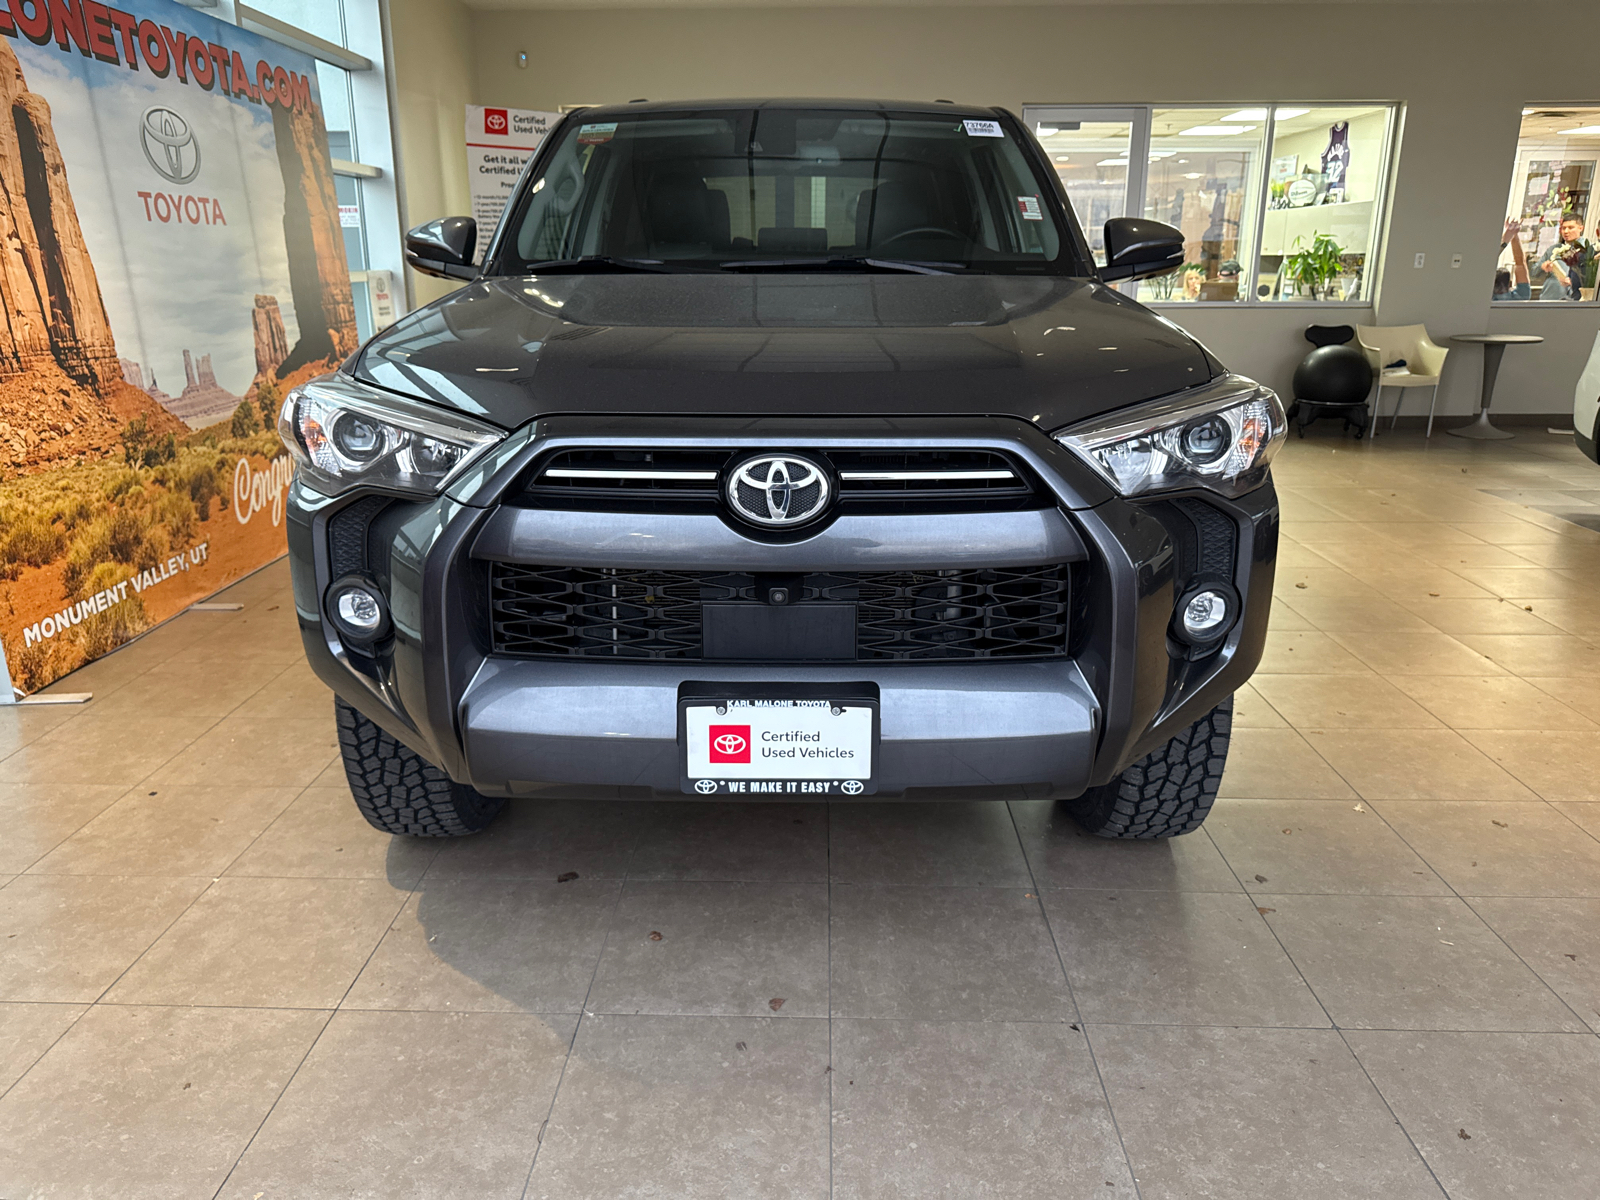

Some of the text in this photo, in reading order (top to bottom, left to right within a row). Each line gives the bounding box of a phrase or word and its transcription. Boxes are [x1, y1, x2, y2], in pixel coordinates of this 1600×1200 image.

[0, 0, 313, 117] ONETOYOTA.COM
[513, 115, 546, 125] Certified
[513, 125, 533, 134] Used
[483, 154, 499, 163] Get
[500, 155, 507, 164] it
[509, 156, 519, 165] all
[479, 165, 516, 175] Certified
[137, 191, 227, 225] TOYOTA
[23, 543, 207, 648] MONUMENT VALLEY, UT
[726, 700, 831, 708] KARL MALONE TOYOTA
[761, 731, 820, 742] Certified
[762, 747, 855, 758] Used Vehicles
[728, 782, 831, 793] WE MAKE IT EASY
